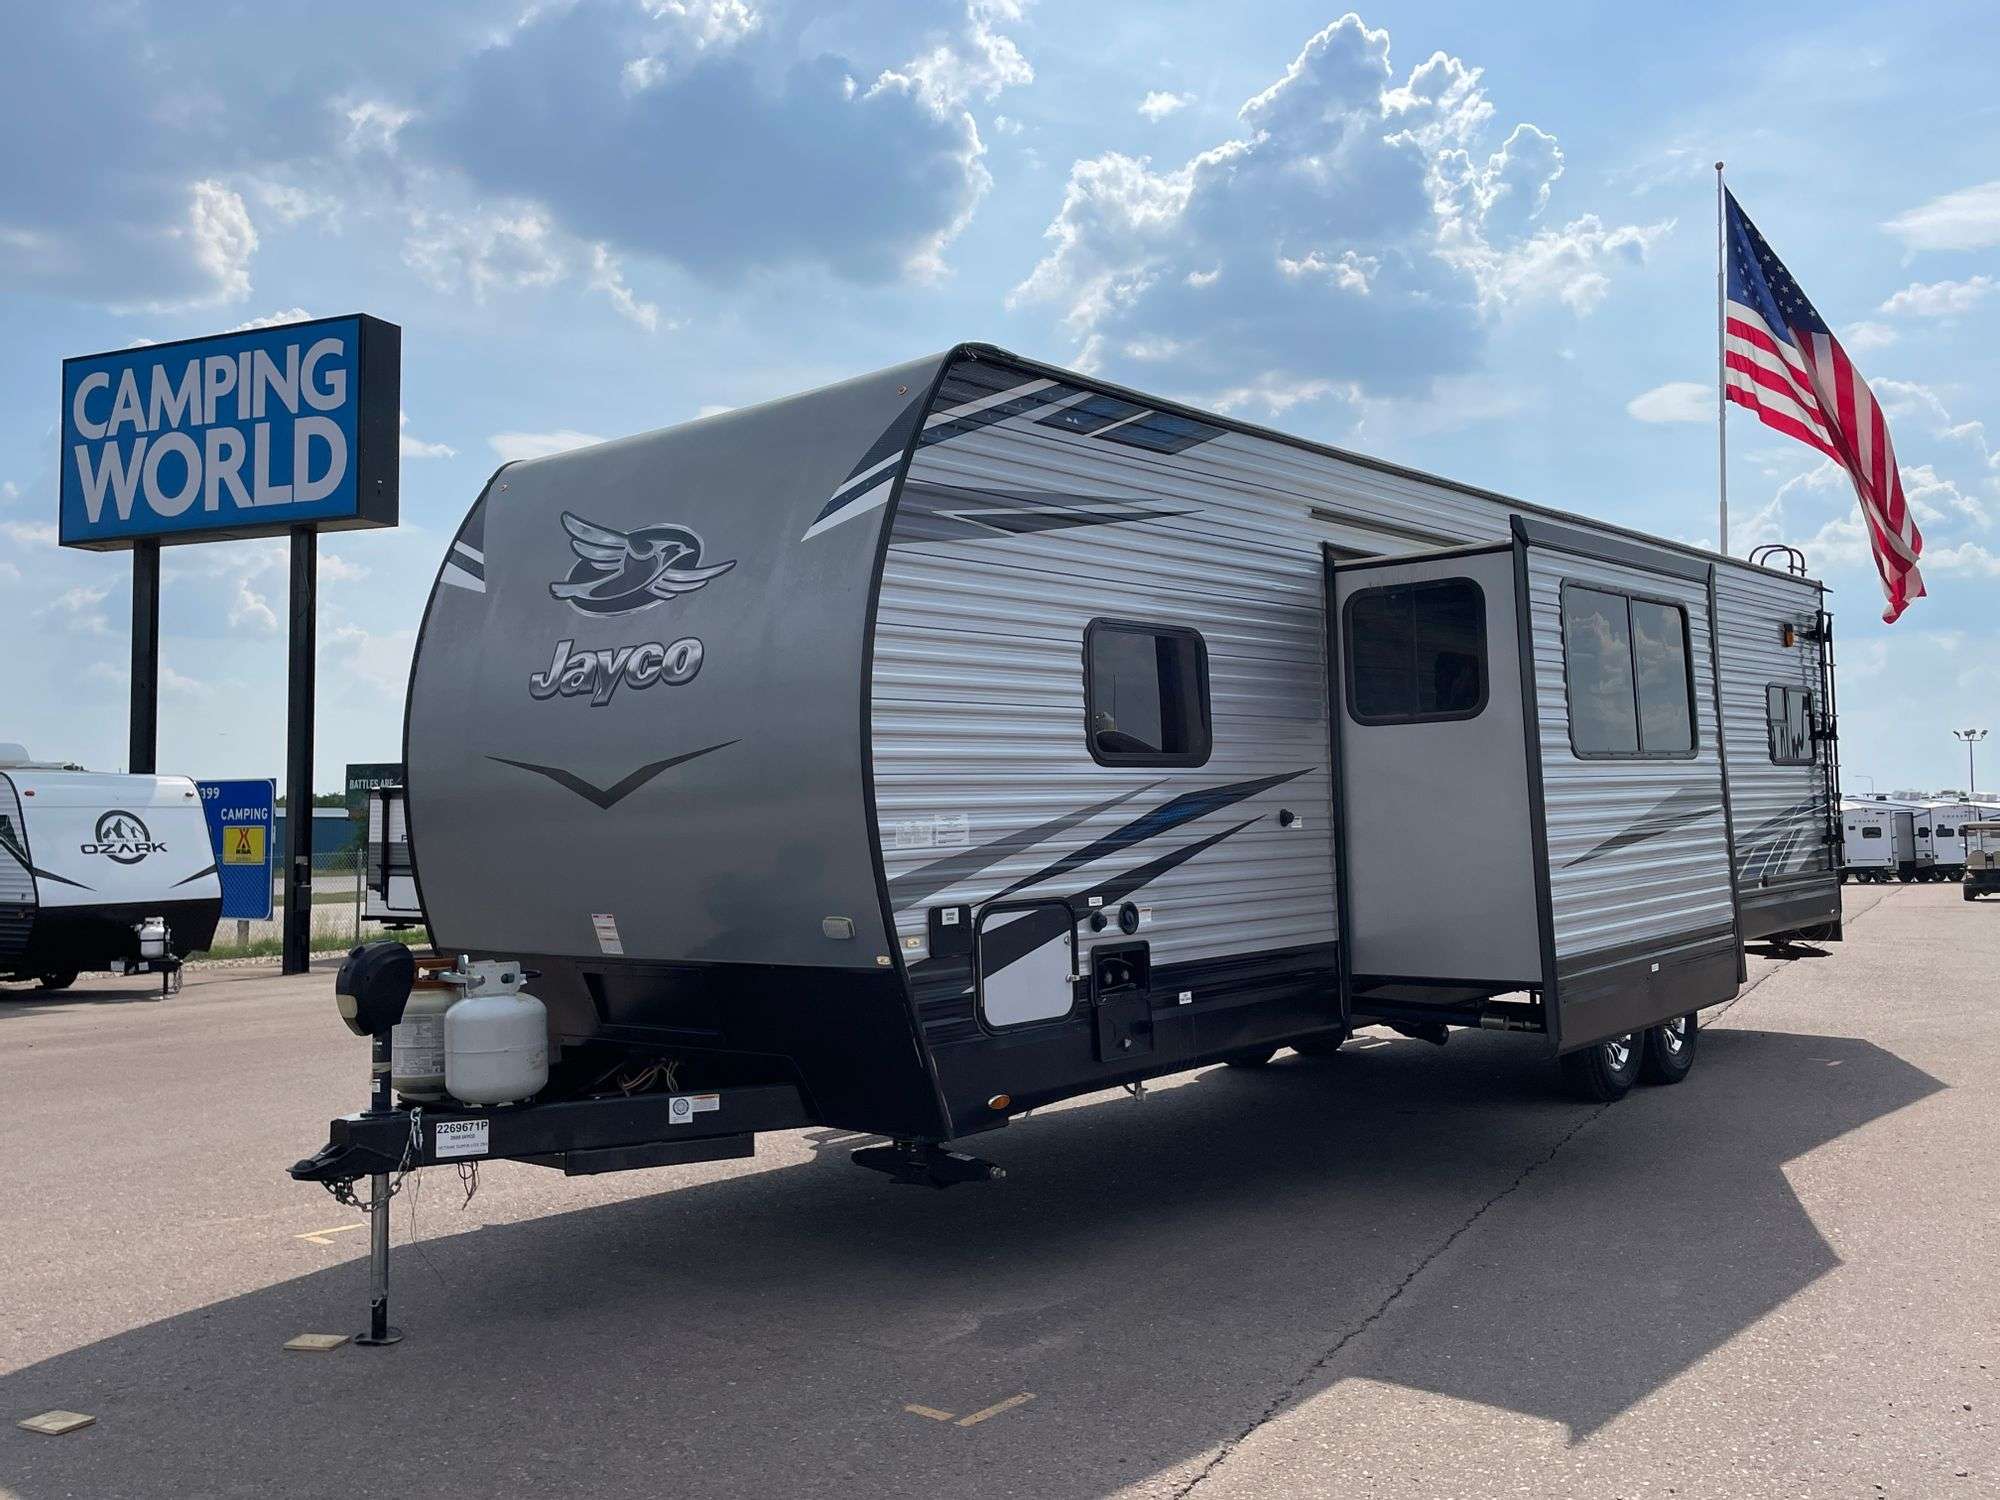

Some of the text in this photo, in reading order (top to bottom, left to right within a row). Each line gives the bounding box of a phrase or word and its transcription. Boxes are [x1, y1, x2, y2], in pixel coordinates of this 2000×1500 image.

[73, 337, 347, 440] CAMPING
[74, 415, 348, 524] WORLD
[529, 637, 704, 707] Jayco
[349, 779, 379, 790] BATTLES
[220, 807, 268, 820] CAMPING
[80, 842, 168, 854] OZARK
[437, 1121, 488, 1134] 2269671P
